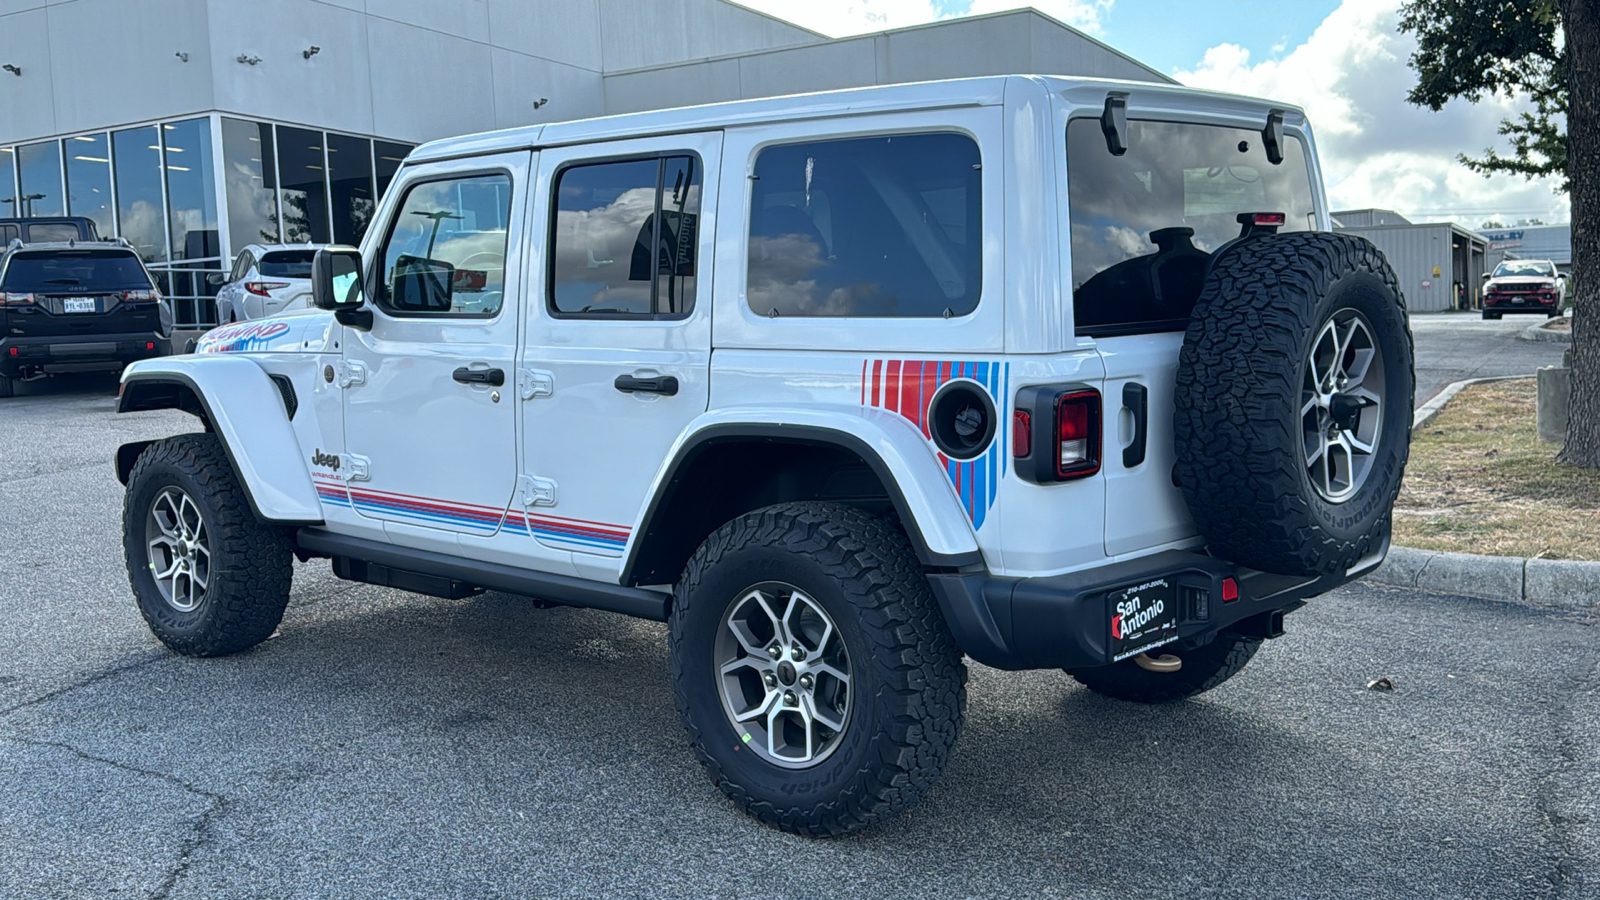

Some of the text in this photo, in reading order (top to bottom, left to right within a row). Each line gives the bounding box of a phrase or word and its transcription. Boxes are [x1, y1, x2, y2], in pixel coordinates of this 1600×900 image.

[312, 448, 340, 472] Jeep
[1116, 596, 1141, 620] San
[1120, 599, 1164, 640] Antonio
